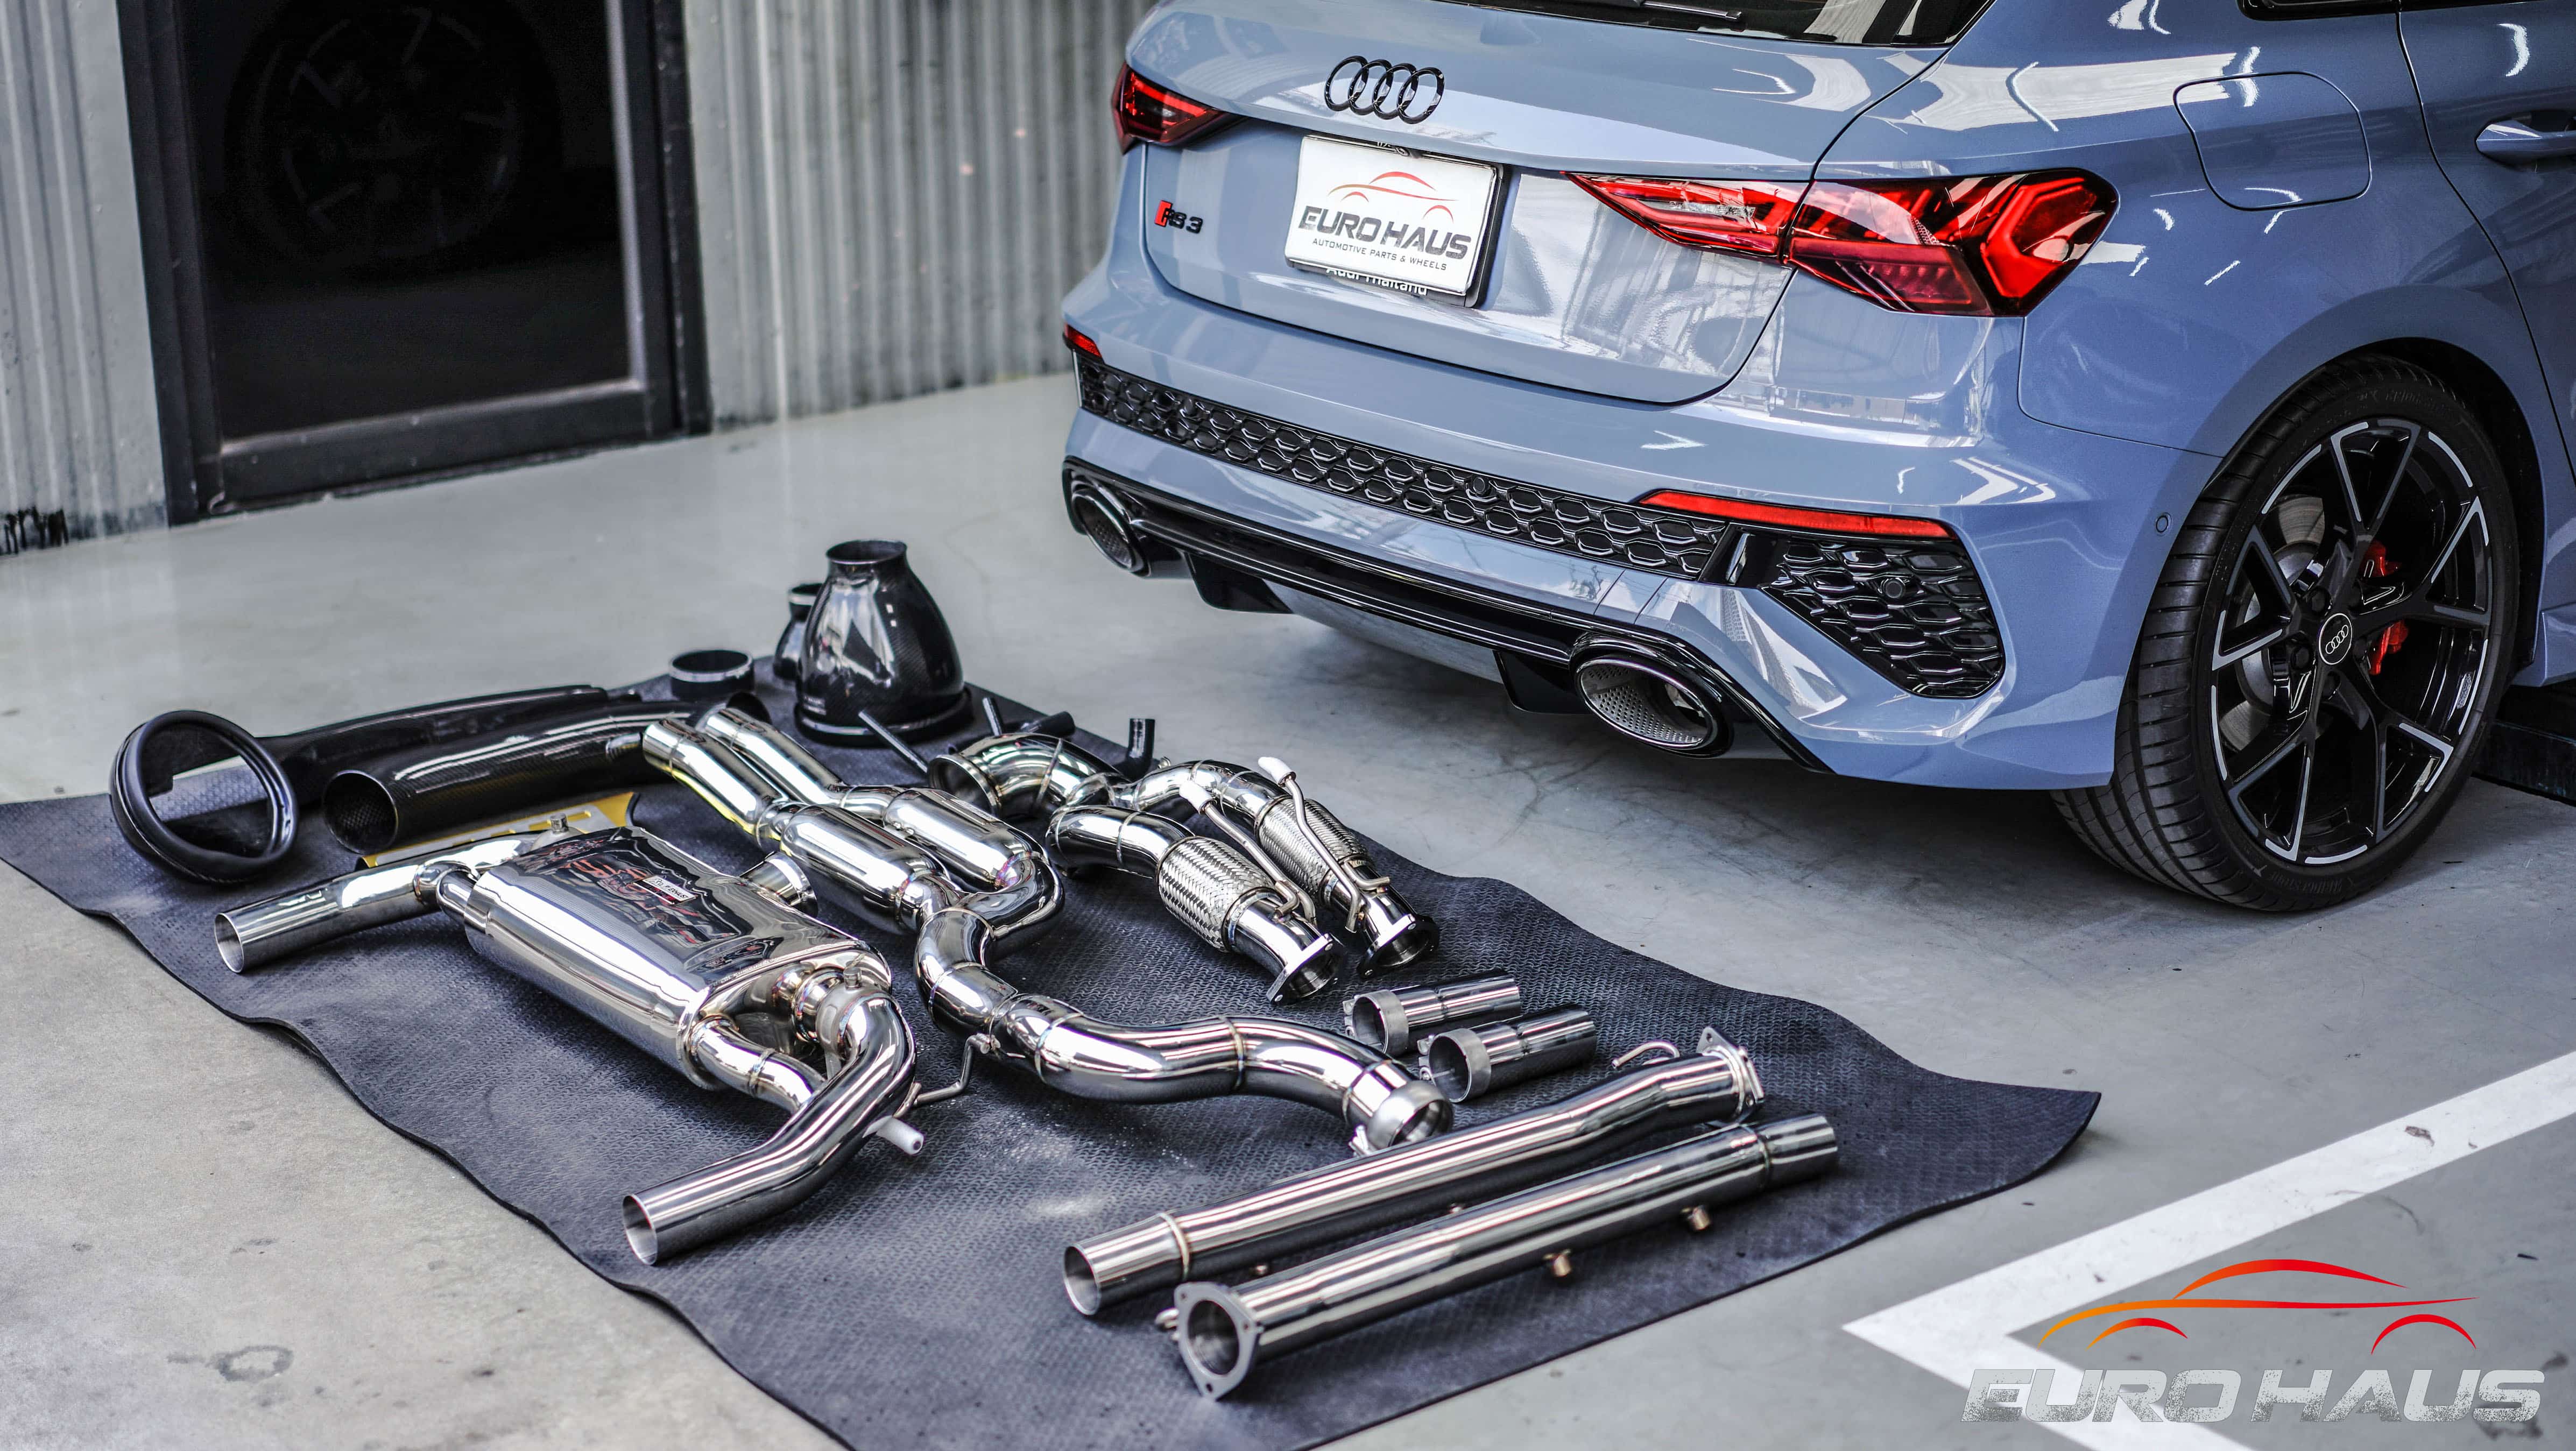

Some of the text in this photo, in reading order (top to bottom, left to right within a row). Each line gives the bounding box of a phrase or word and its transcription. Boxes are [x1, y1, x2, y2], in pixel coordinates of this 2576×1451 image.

[1298, 205, 1472, 260] EURO HAUS
[1312, 238, 1367, 255] AUTOMOTIVE
[1370, 249, 1398, 261] PARTS
[1410, 257, 1447, 271] WHEELS
